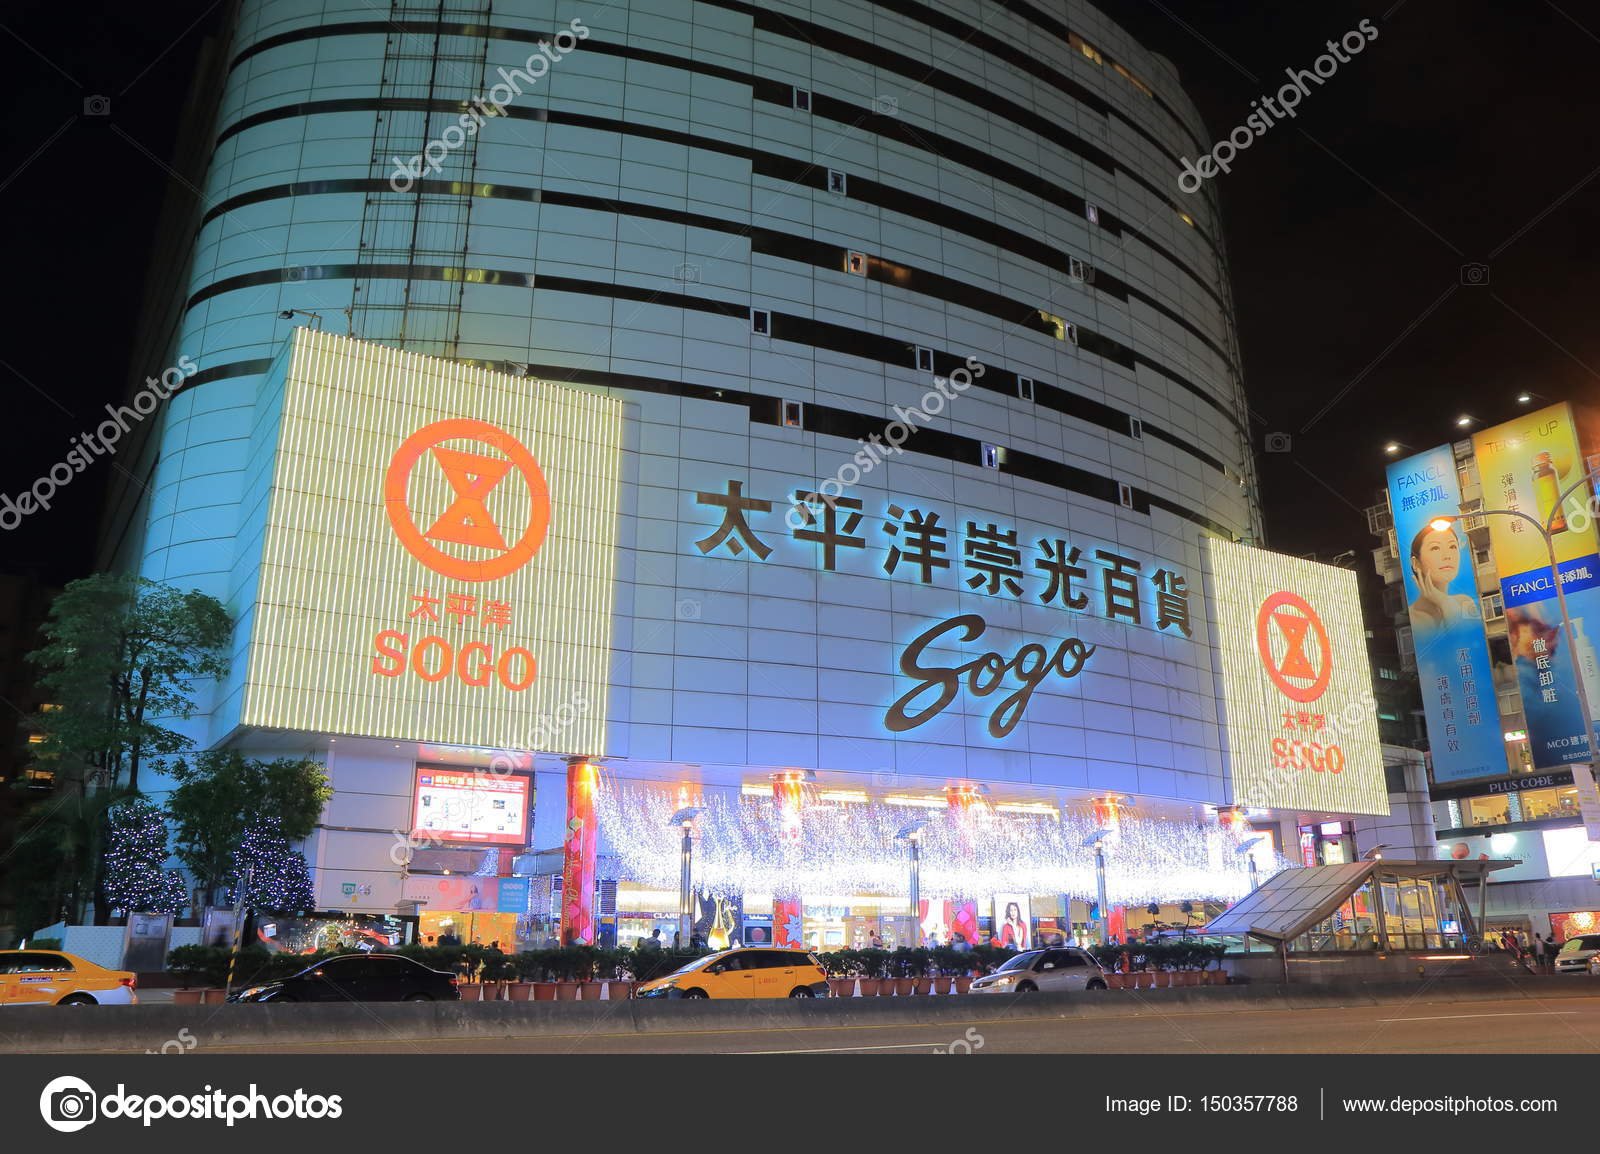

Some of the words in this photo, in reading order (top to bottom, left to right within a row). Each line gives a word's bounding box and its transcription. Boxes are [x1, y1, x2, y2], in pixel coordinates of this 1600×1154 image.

[1539, 420, 1559, 437] UP
[1397, 465, 1448, 491] FANCL
[694, 479, 1193, 638] 太平洋崇光百貨
[1510, 577, 1553, 597] FANCL
[408, 589, 512, 631] 太平洋
[372, 629, 537, 691] SOGO
[884, 614, 1096, 738] Sogo
[1272, 738, 1345, 774] SOGO
[1489, 780, 1518, 793] PLUS
